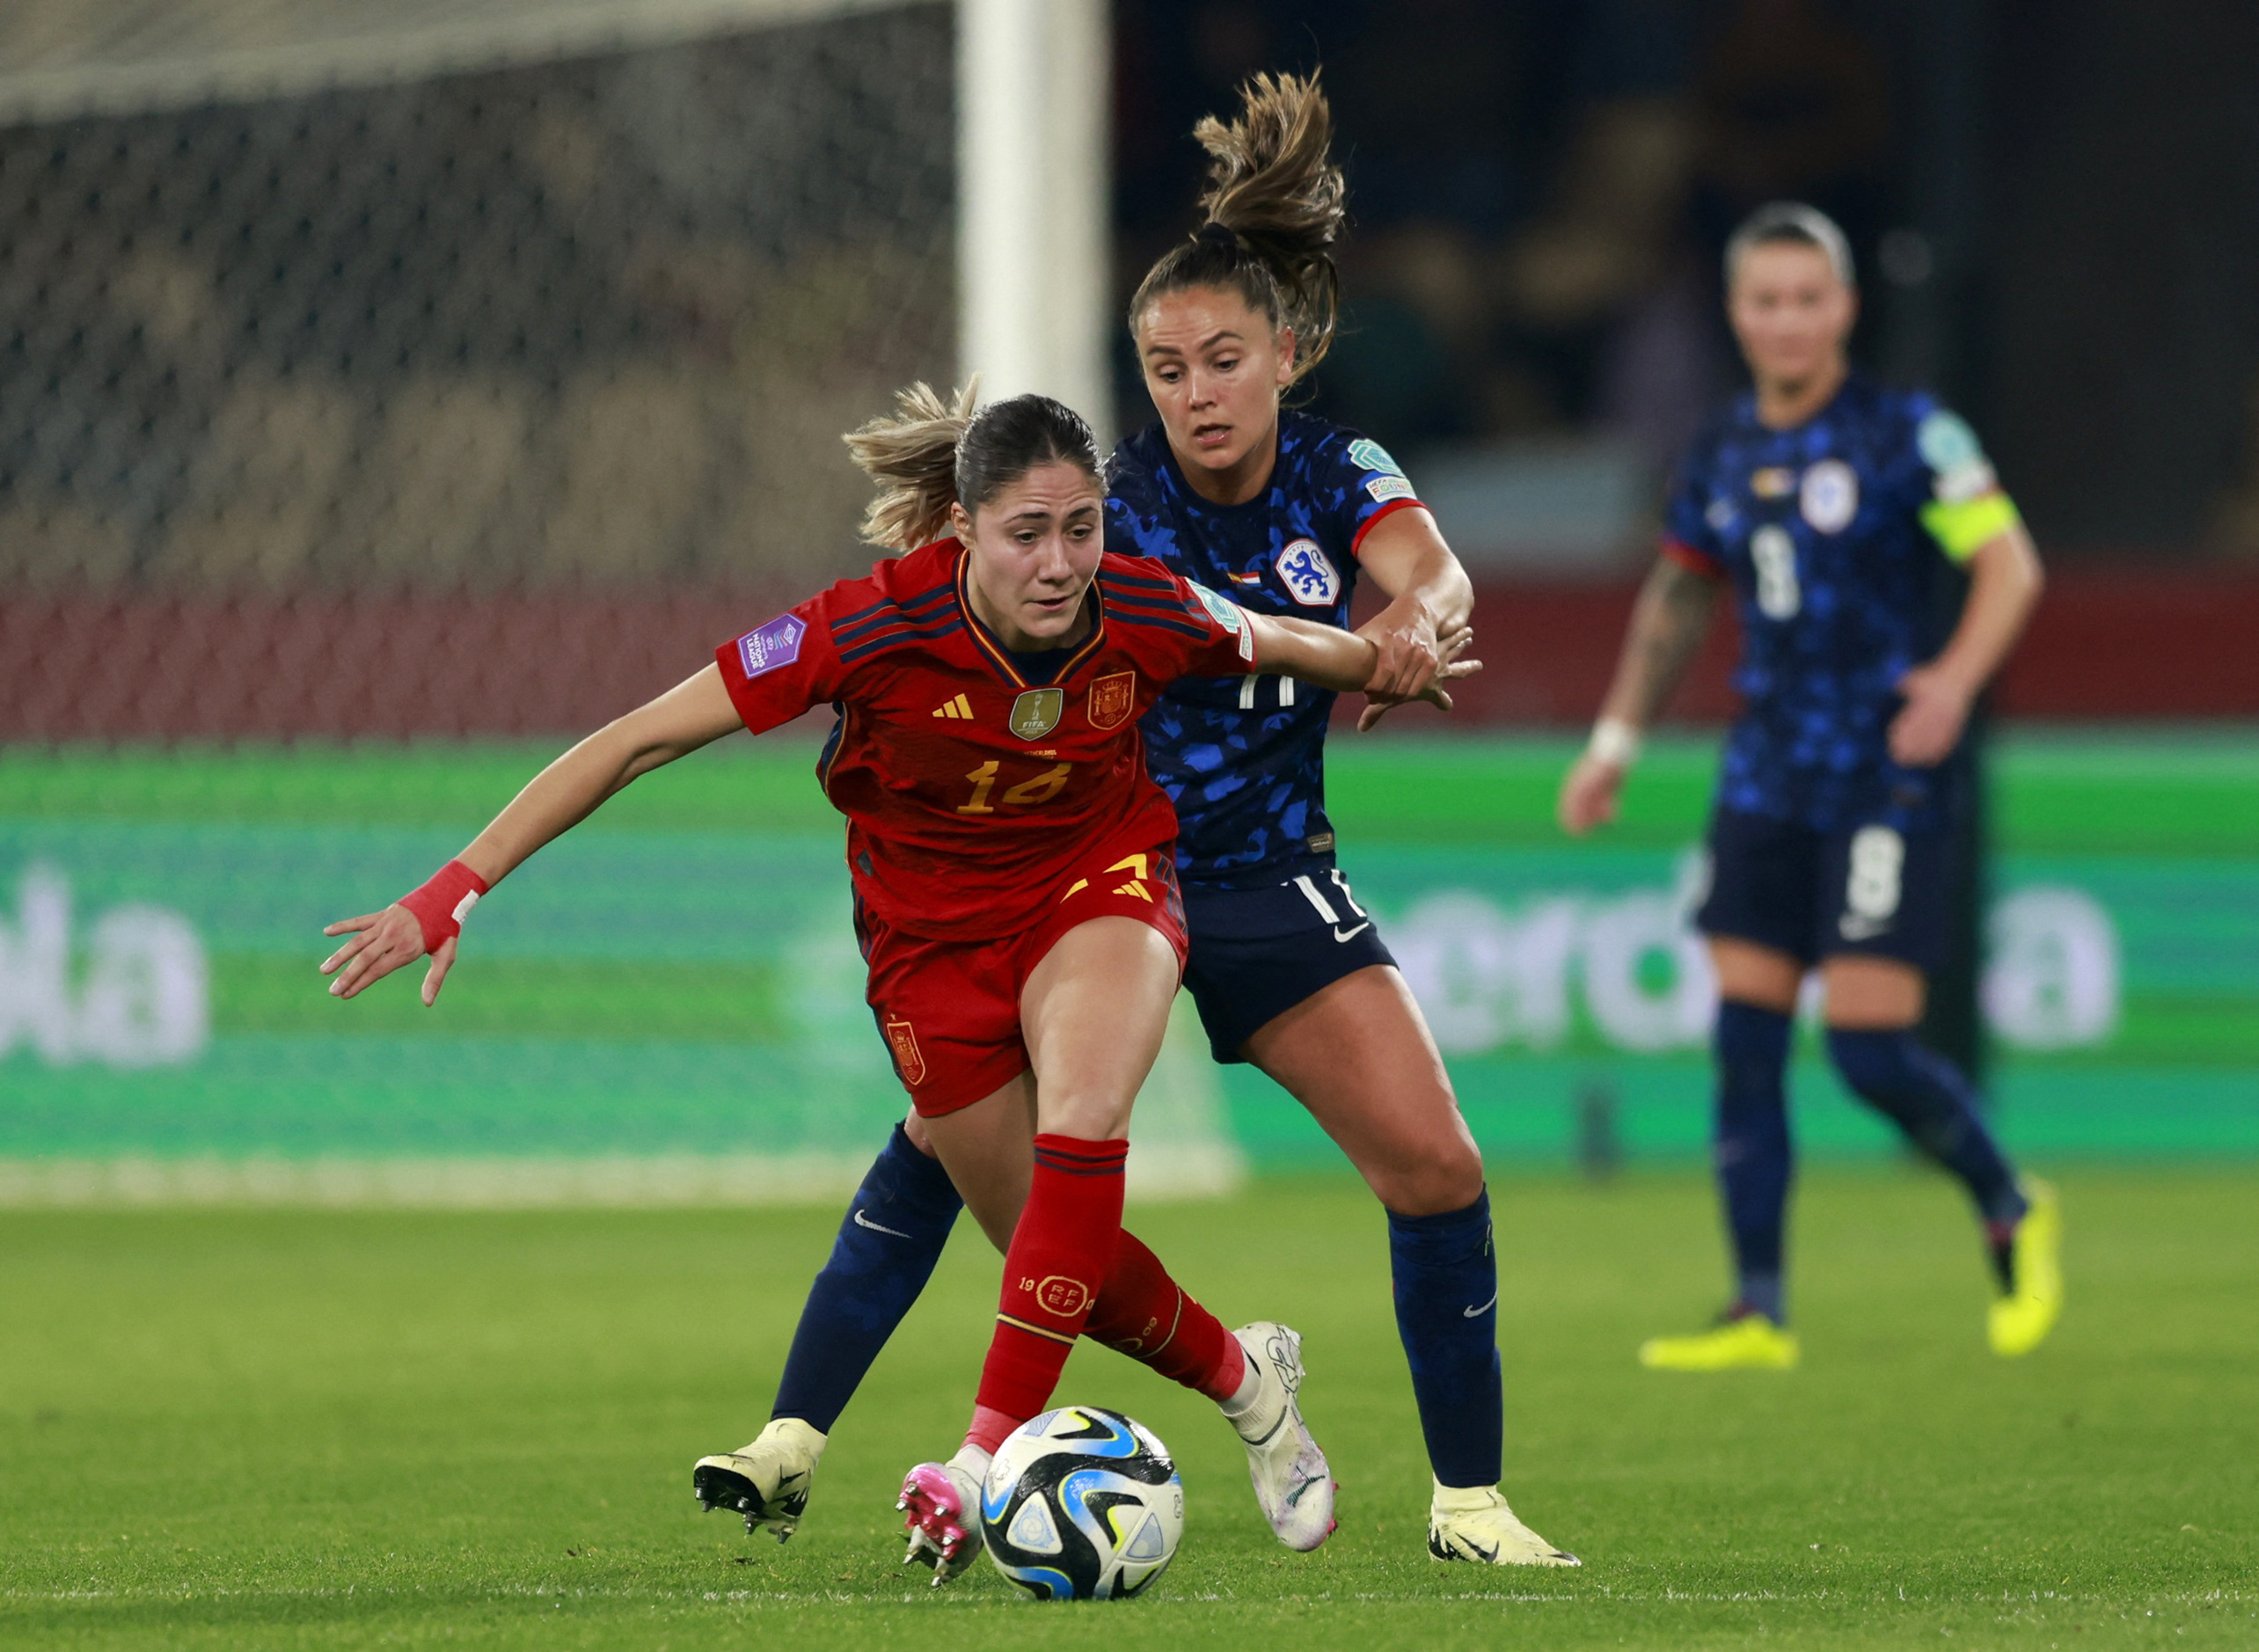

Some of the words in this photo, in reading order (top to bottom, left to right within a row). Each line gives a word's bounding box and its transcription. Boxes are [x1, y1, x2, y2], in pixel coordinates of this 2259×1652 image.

[746, 638, 759, 669] LEAGUE
[752, 632, 766, 669] NATIONS
[1846, 824, 1905, 920] 8
[0, 859, 211, 1069] la
[1018, 1276, 1035, 1292] 19
